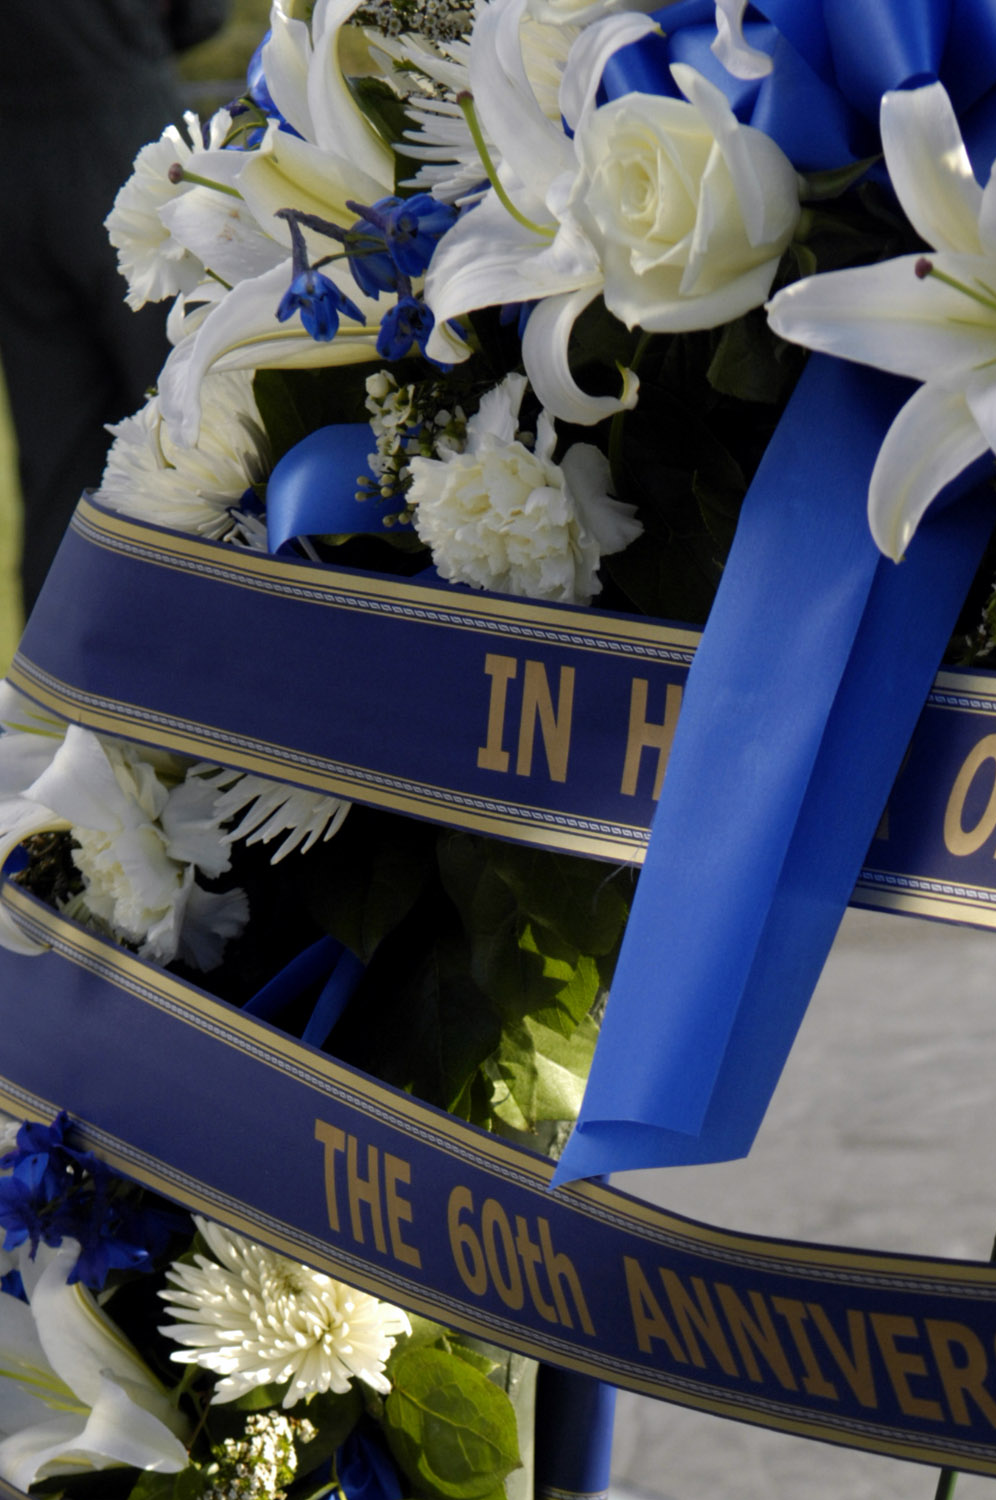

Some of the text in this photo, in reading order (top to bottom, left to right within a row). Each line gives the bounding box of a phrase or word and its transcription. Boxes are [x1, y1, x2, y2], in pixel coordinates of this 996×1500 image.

[477, 653, 575, 783] IN
[314, 1118, 422, 1270] THE
[447, 1185, 596, 1337] 60th
